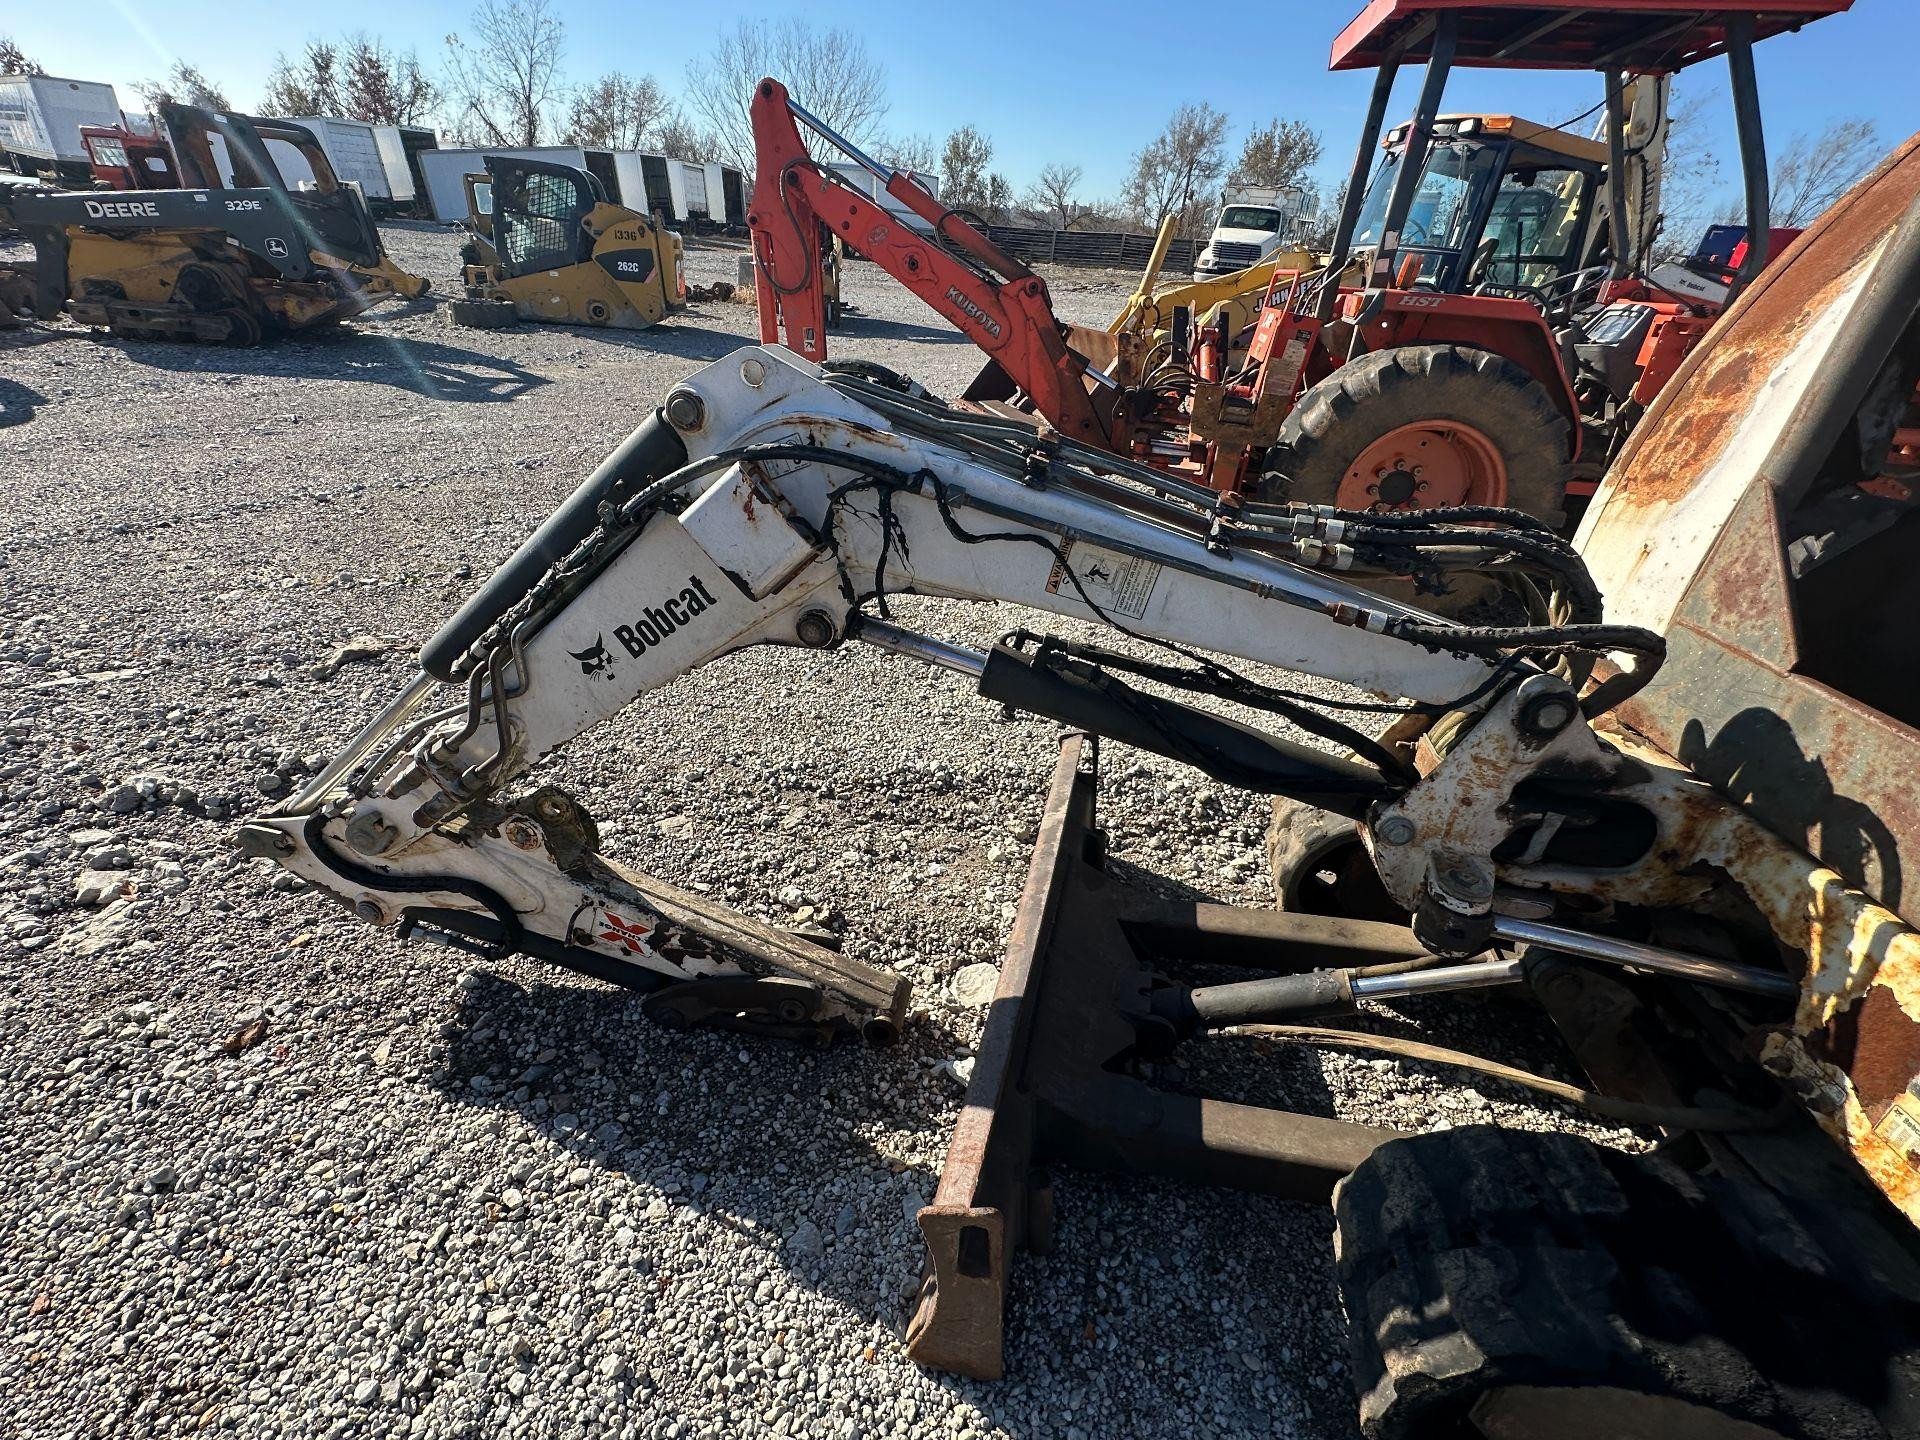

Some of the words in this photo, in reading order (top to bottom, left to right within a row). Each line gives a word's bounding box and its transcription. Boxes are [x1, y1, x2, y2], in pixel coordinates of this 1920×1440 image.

[84, 200, 160, 218] DEERE
[225, 200, 262, 211] 329E
[617, 261, 639, 273] 262C
[1253, 288, 1290, 313] JHN
[1398, 295, 1446, 307] HST
[944, 284, 1002, 340] KUBOTA
[1052, 536, 1070, 578] WANIN
[612, 574, 718, 660] Bobcat
